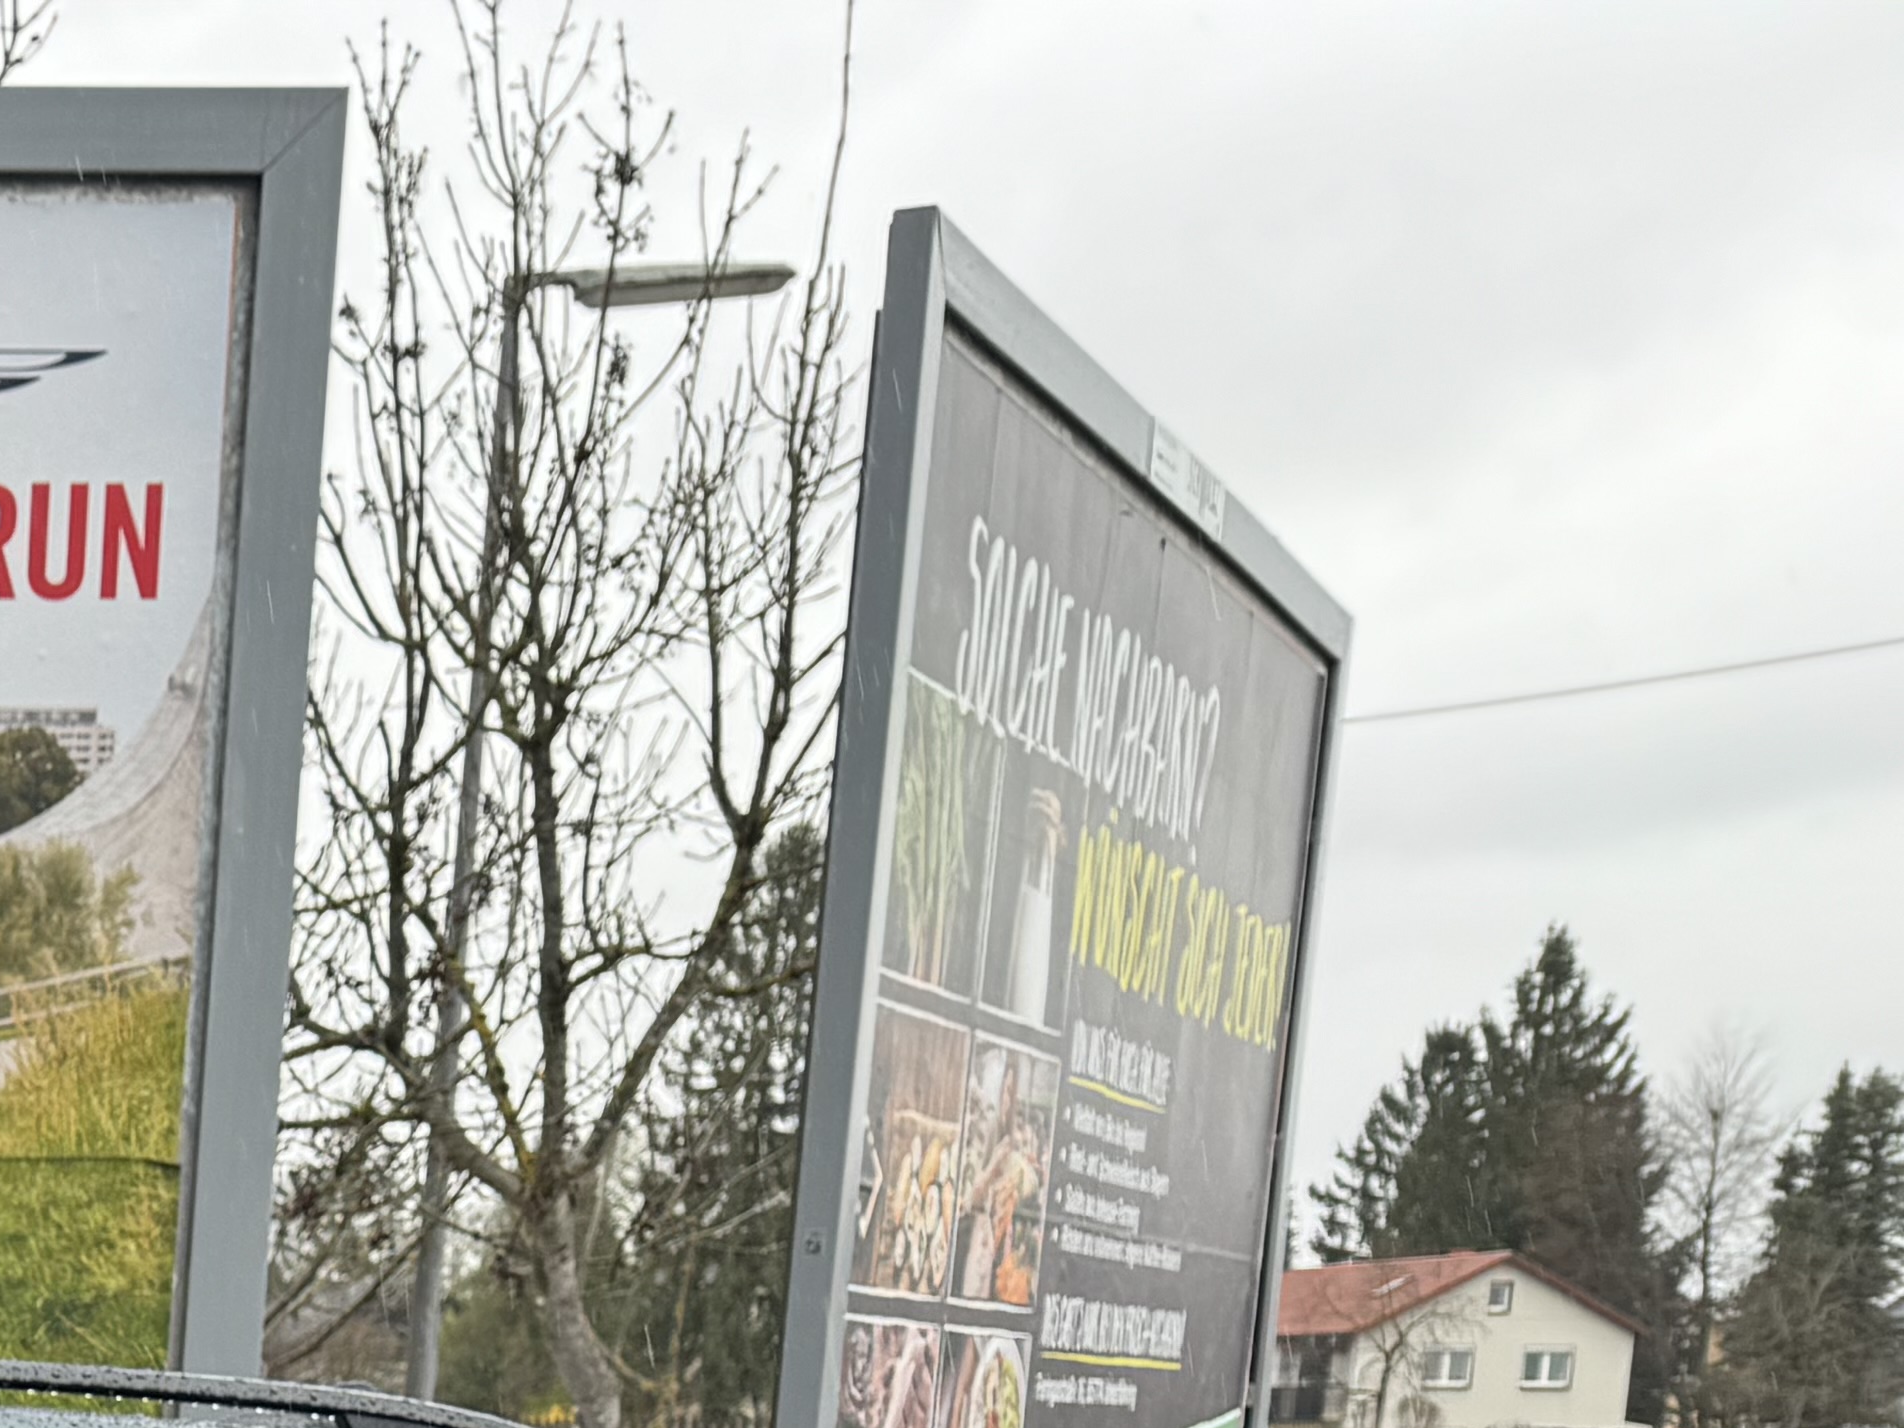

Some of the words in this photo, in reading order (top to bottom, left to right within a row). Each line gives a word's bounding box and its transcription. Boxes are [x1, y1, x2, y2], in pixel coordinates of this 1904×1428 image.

[955, 514, 1075, 764] SOLCHE
[1071, 806, 1185, 1008] WÜNSCHT
[1176, 872, 1231, 1031] SICH
